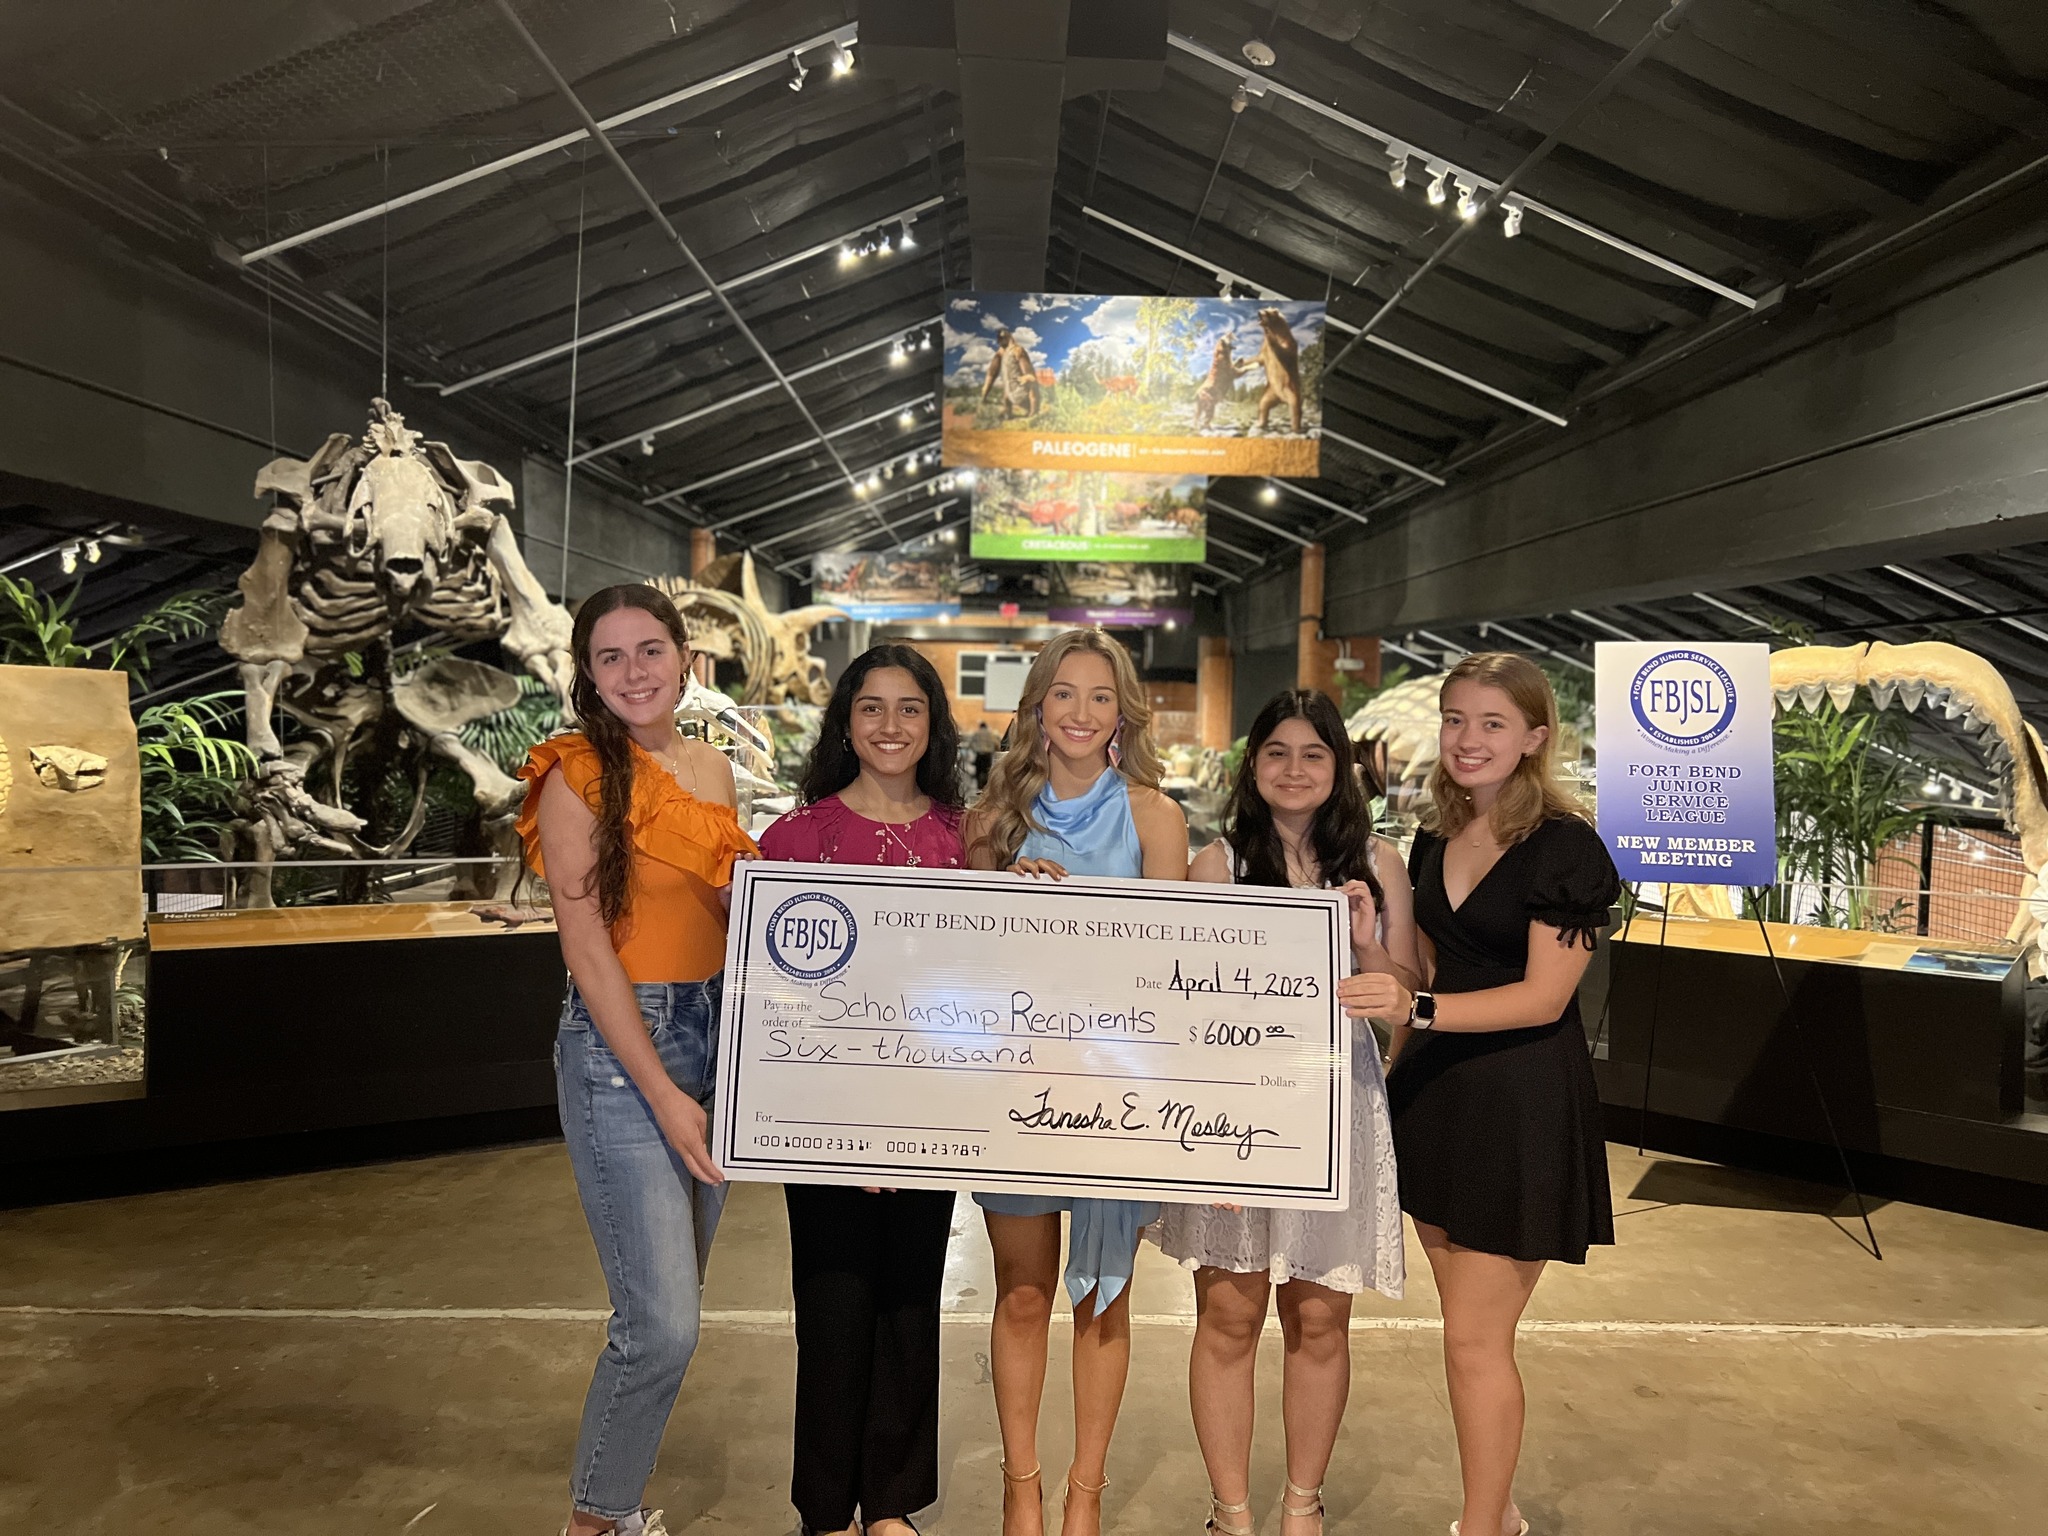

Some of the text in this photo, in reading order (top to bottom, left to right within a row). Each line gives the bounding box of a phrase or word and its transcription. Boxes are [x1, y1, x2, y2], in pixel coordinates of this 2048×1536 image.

[1032, 440, 1131, 458] PALEOGENE
[1633, 652, 1734, 697] FORT BEND JUNIOR SERVICE LEAGUE
[1649, 679, 1720, 725] FBJSL
[1653, 730, 1716, 745] ESTABLISHED 2001
[1664, 745, 1690, 756] Making
[1628, 764, 1741, 779] FORT BEND
[1647, 779, 1722, 793] JUNIOR
[1642, 794, 1729, 808] SERVICE
[1646, 809, 1726, 823] LEAGUE
[1616, 835, 1756, 853] NEW MEMBER
[1640, 851, 1733, 867] MEETING
[768, 893, 856, 936] FORT BEND JUNIOR SERVICE LEAGUE
[873, 910, 1268, 946] FORT BEND JUNIOR SERVICE LEAGUE
[781, 917, 843, 960] FBJSL
[782, 964, 822, 978] ESTABLISHED
[1135, 976, 1162, 990] Date
[1168, 959, 1222, 1000] April
[764, 999, 812, 1012] Pay to the
[818, 980, 1156, 1042] Scholarship Recipients
[762, 1017, 803, 1028] order of
[1260, 1075, 1297, 1088] Dollars
[755, 1111, 773, 1123] For
